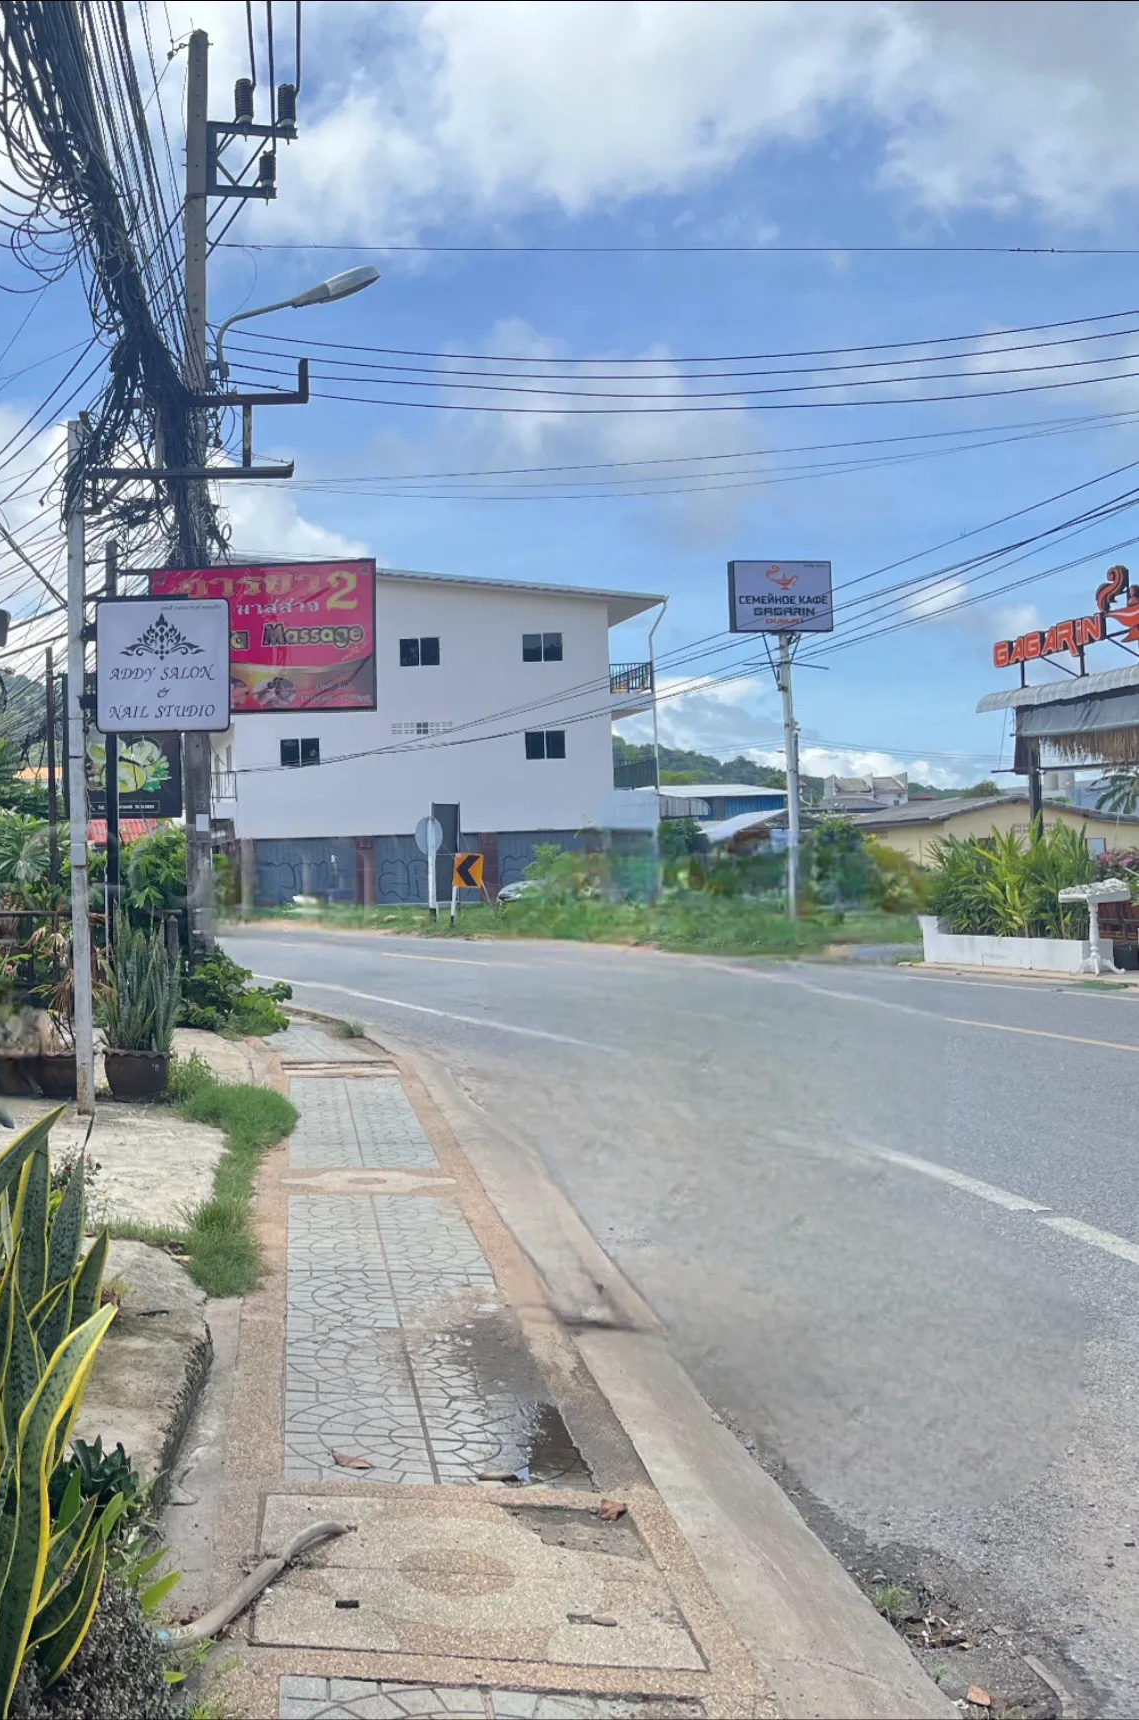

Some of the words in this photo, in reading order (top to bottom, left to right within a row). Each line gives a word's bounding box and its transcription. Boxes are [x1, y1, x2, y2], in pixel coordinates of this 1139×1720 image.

[326, 569, 358, 611] 2
[738, 593, 796, 605] СЕМЕЙНОЕ
[799, 595, 828, 605] КАФЕ
[753, 607, 816, 616] GAGARIN
[263, 623, 364, 649] Massage
[109, 667, 156, 683] ADDY
[160, 664, 215, 681] SALON
[157, 688, 170, 698] &
[109, 704, 149, 720] NAIL
[155, 704, 216, 718] STUDIO
